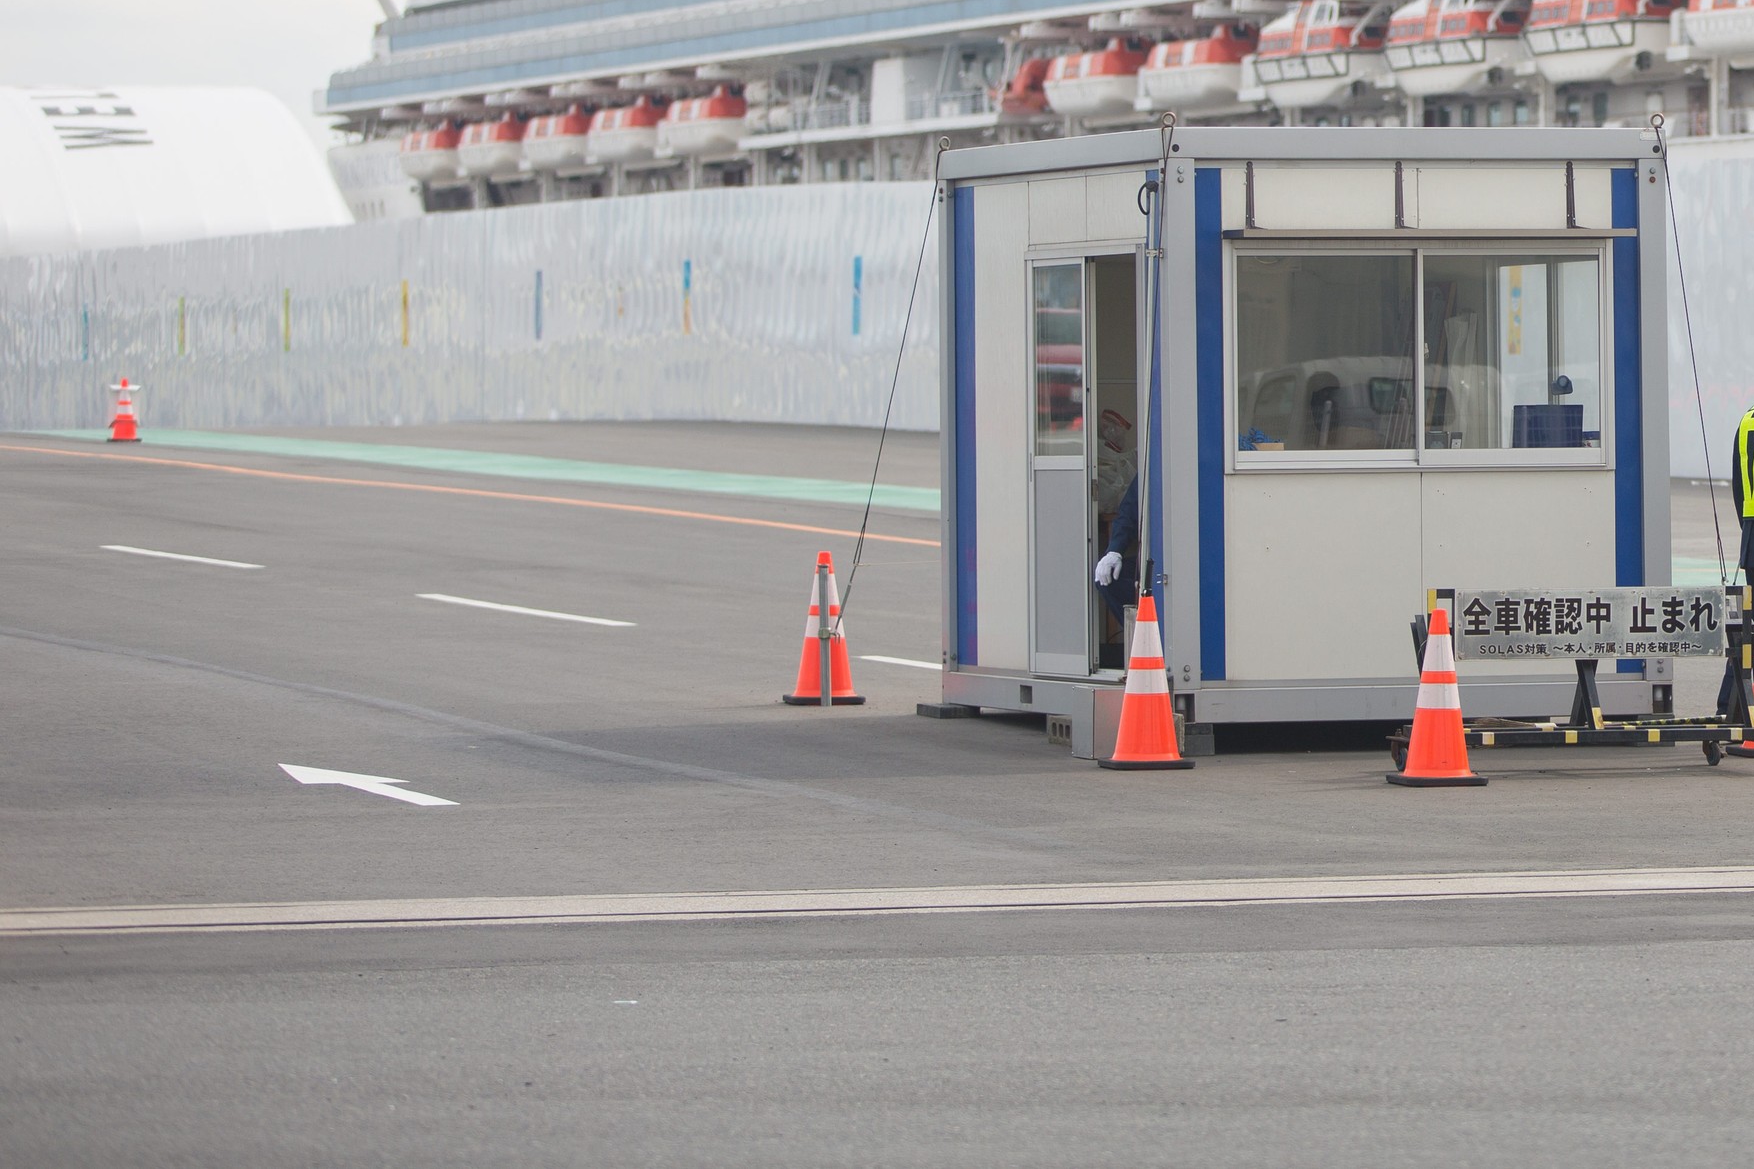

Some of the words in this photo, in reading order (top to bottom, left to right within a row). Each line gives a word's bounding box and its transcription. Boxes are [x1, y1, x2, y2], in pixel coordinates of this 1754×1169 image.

[24, 85, 155, 150] WEL
[1463, 597, 1611, 636] 全車確認中
[1629, 596, 1719, 634] 止まれ
[1480, 643, 1547, 655] SOLAS対策
